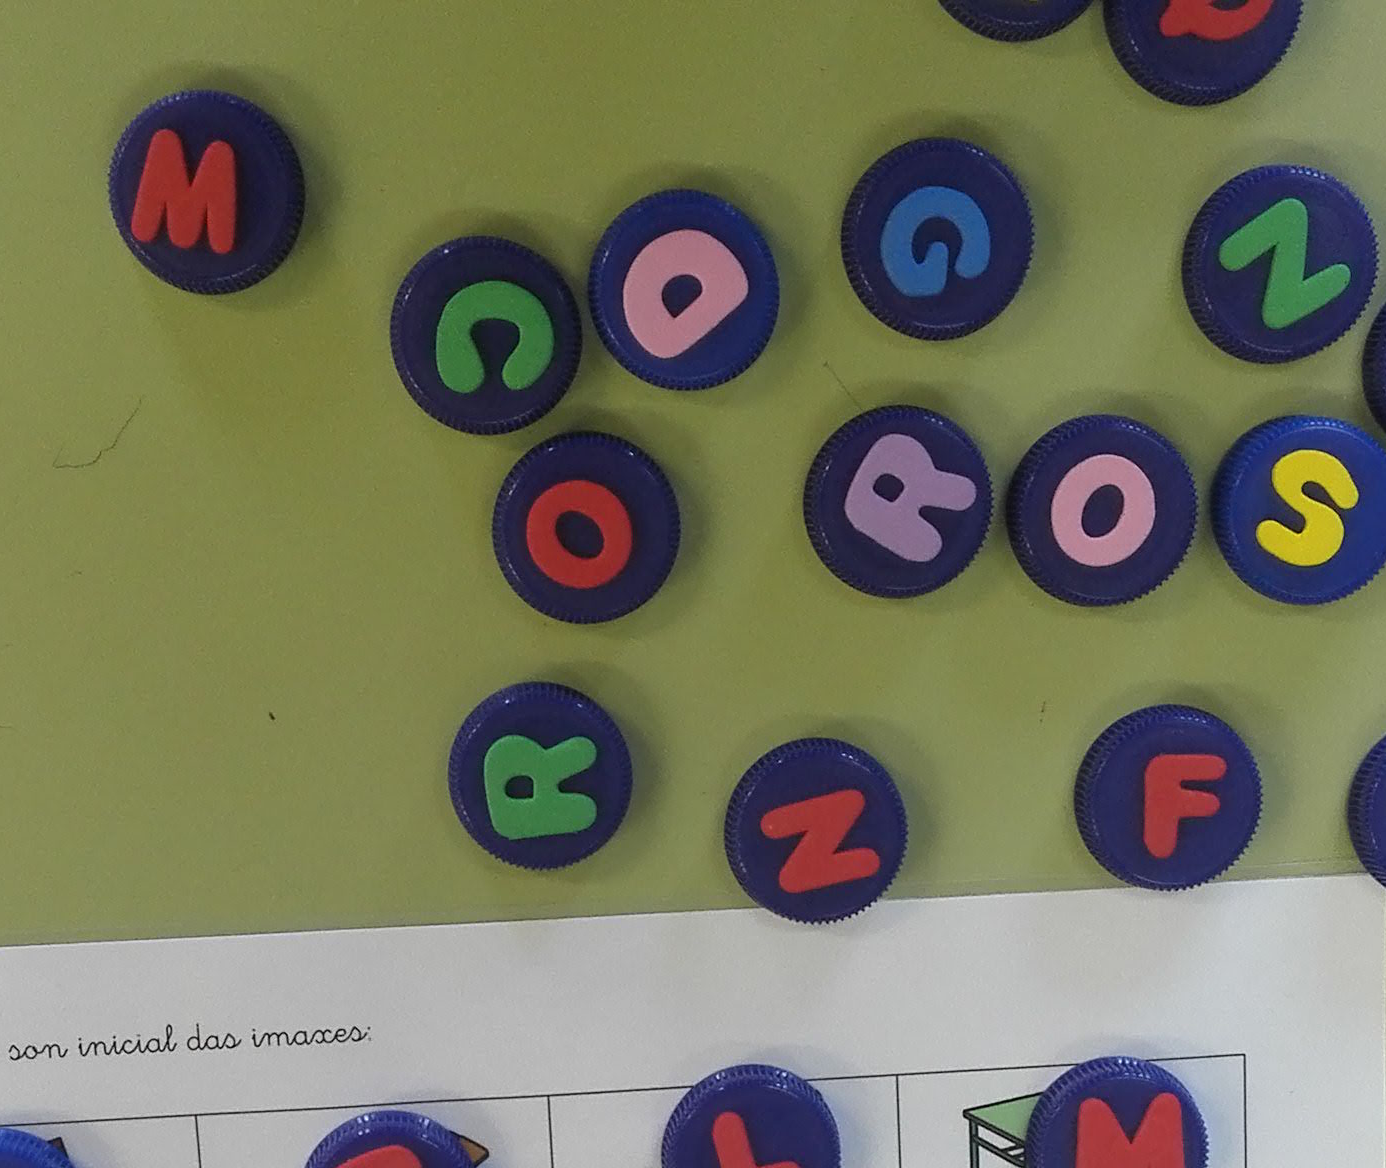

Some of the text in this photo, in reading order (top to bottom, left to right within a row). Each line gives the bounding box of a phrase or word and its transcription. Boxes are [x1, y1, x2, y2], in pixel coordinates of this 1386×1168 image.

[131, 129, 235, 253] M
[880, 186, 991, 297] G
[436, 282, 552, 392] C
[623, 230, 748, 358] D
[527, 480, 631, 588] O
[845, 434, 976, 561] R
[1051, 454, 1155, 566] O
[1256, 450, 1359, 566] S
[484, 736, 595, 839] R
[1143, 754, 1226, 858] F
[8, 1043, 69, 1062] son
[77, 1023, 178, 1058] inicial
[186, 1022, 243, 1052] das
[251, 1025, 373, 1049] imaxes:
